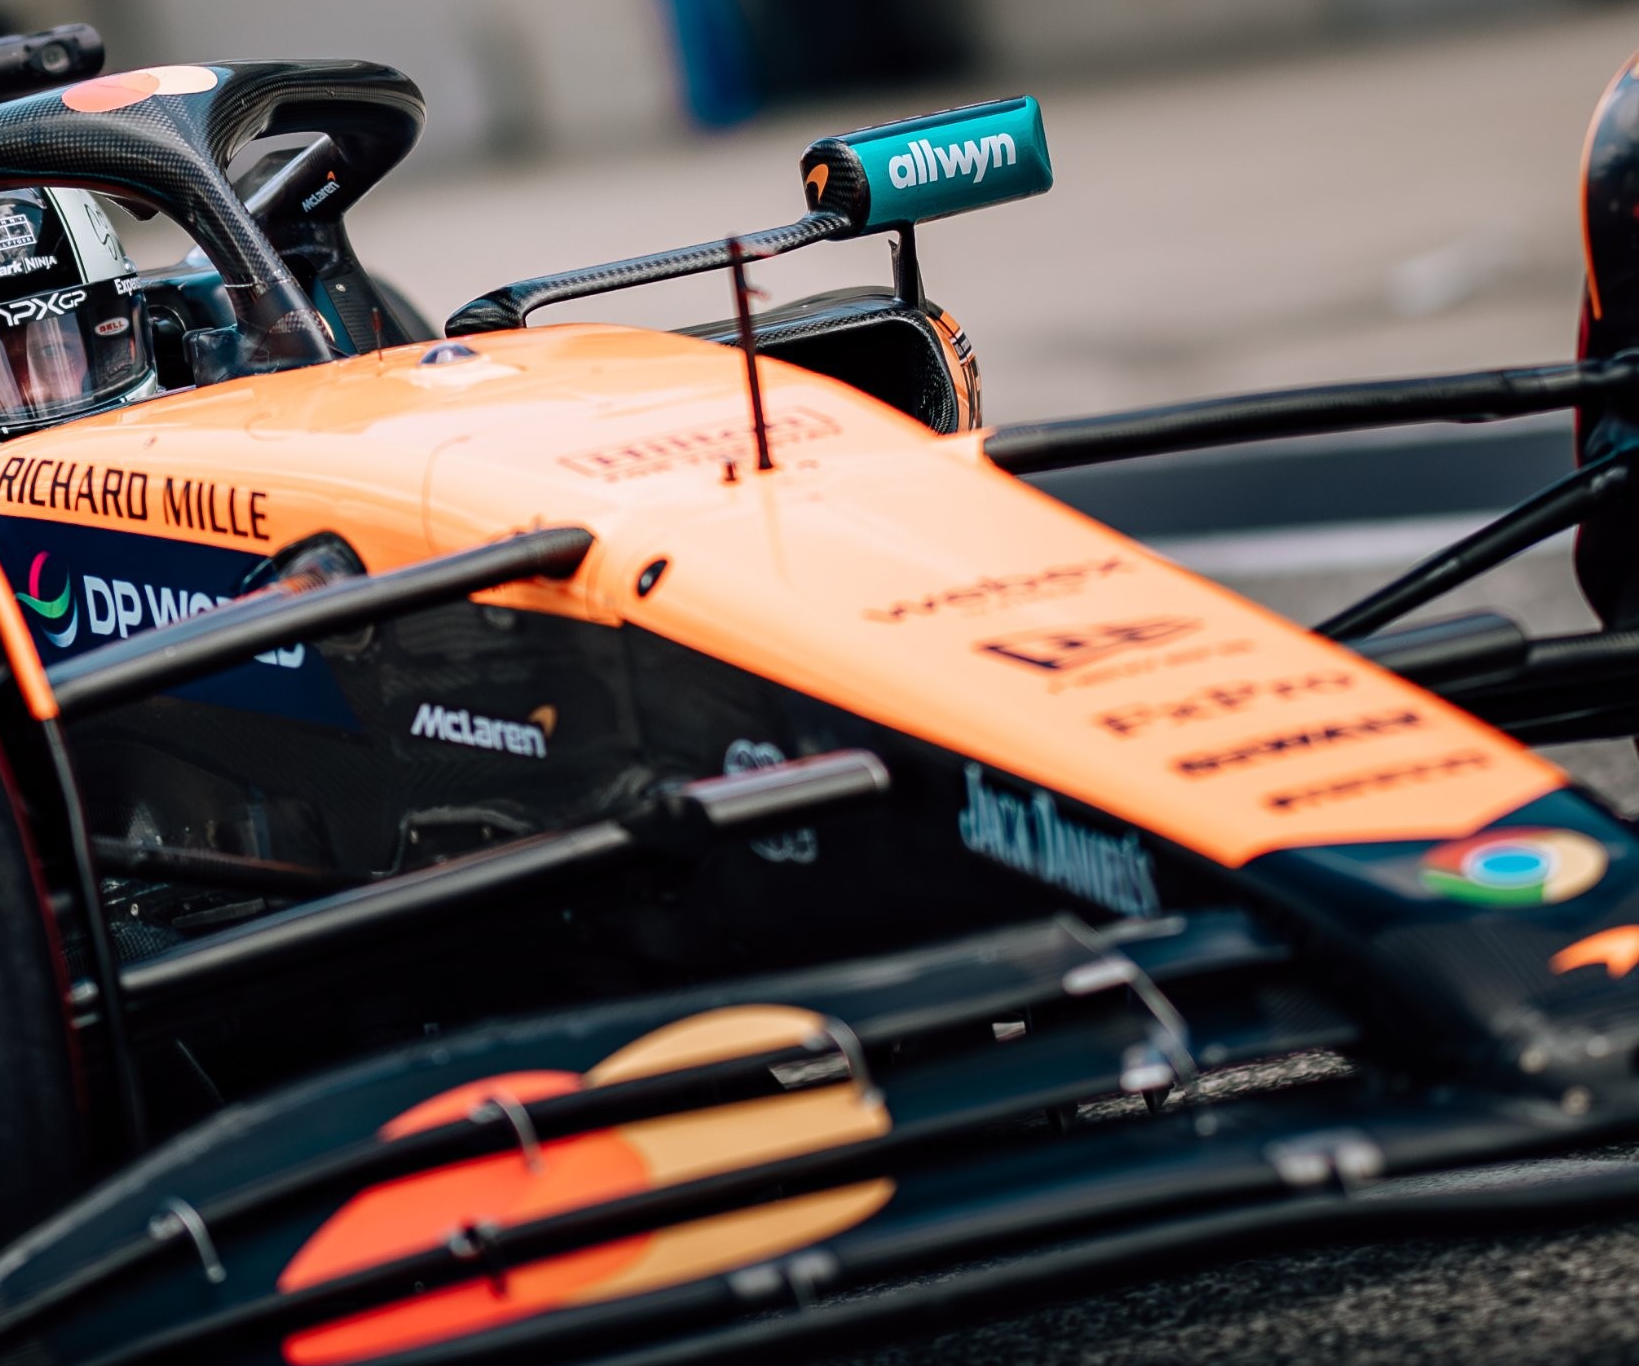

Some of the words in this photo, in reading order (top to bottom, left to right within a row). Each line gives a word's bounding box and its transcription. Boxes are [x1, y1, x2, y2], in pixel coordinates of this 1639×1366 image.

[889, 131, 1016, 189] allwyn
[302, 181, 340, 213] McLaren
[98, 321, 124, 333] BELL
[163, 477, 270, 540] MILLE
[83, 574, 143, 639] DP
[411, 703, 547, 759] McLaren
